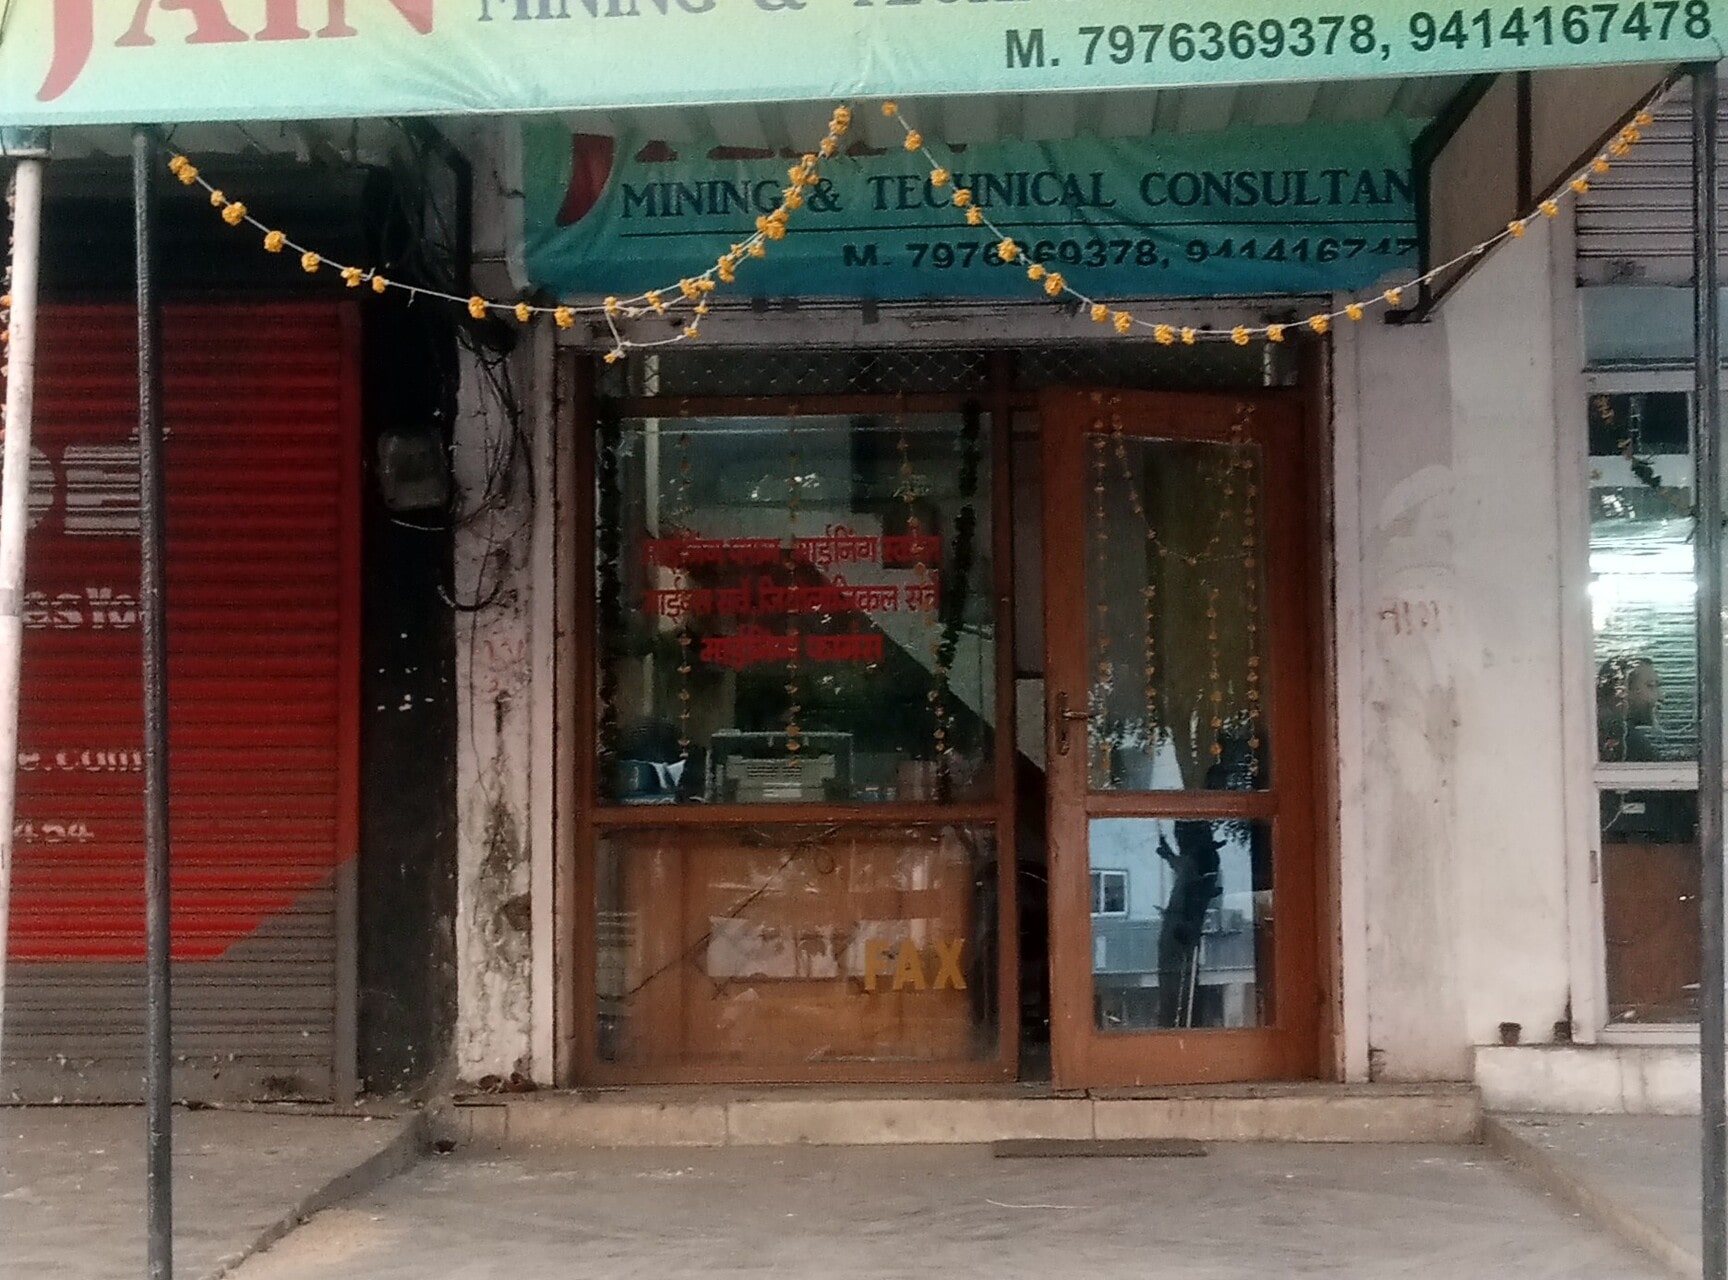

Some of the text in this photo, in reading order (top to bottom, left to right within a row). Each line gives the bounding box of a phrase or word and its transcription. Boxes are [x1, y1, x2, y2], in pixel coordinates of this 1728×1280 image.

[1004, 26, 1061, 70] M.
[1078, 12, 1393, 67] 7976369378,
[620, 177, 784, 219] MINING
[806, 177, 843, 214] &
[866, 170, 1117, 211] TECHNICAL
[1139, 168, 1415, 207] CONSULTAN
[863, 937, 968, 993] FAX
